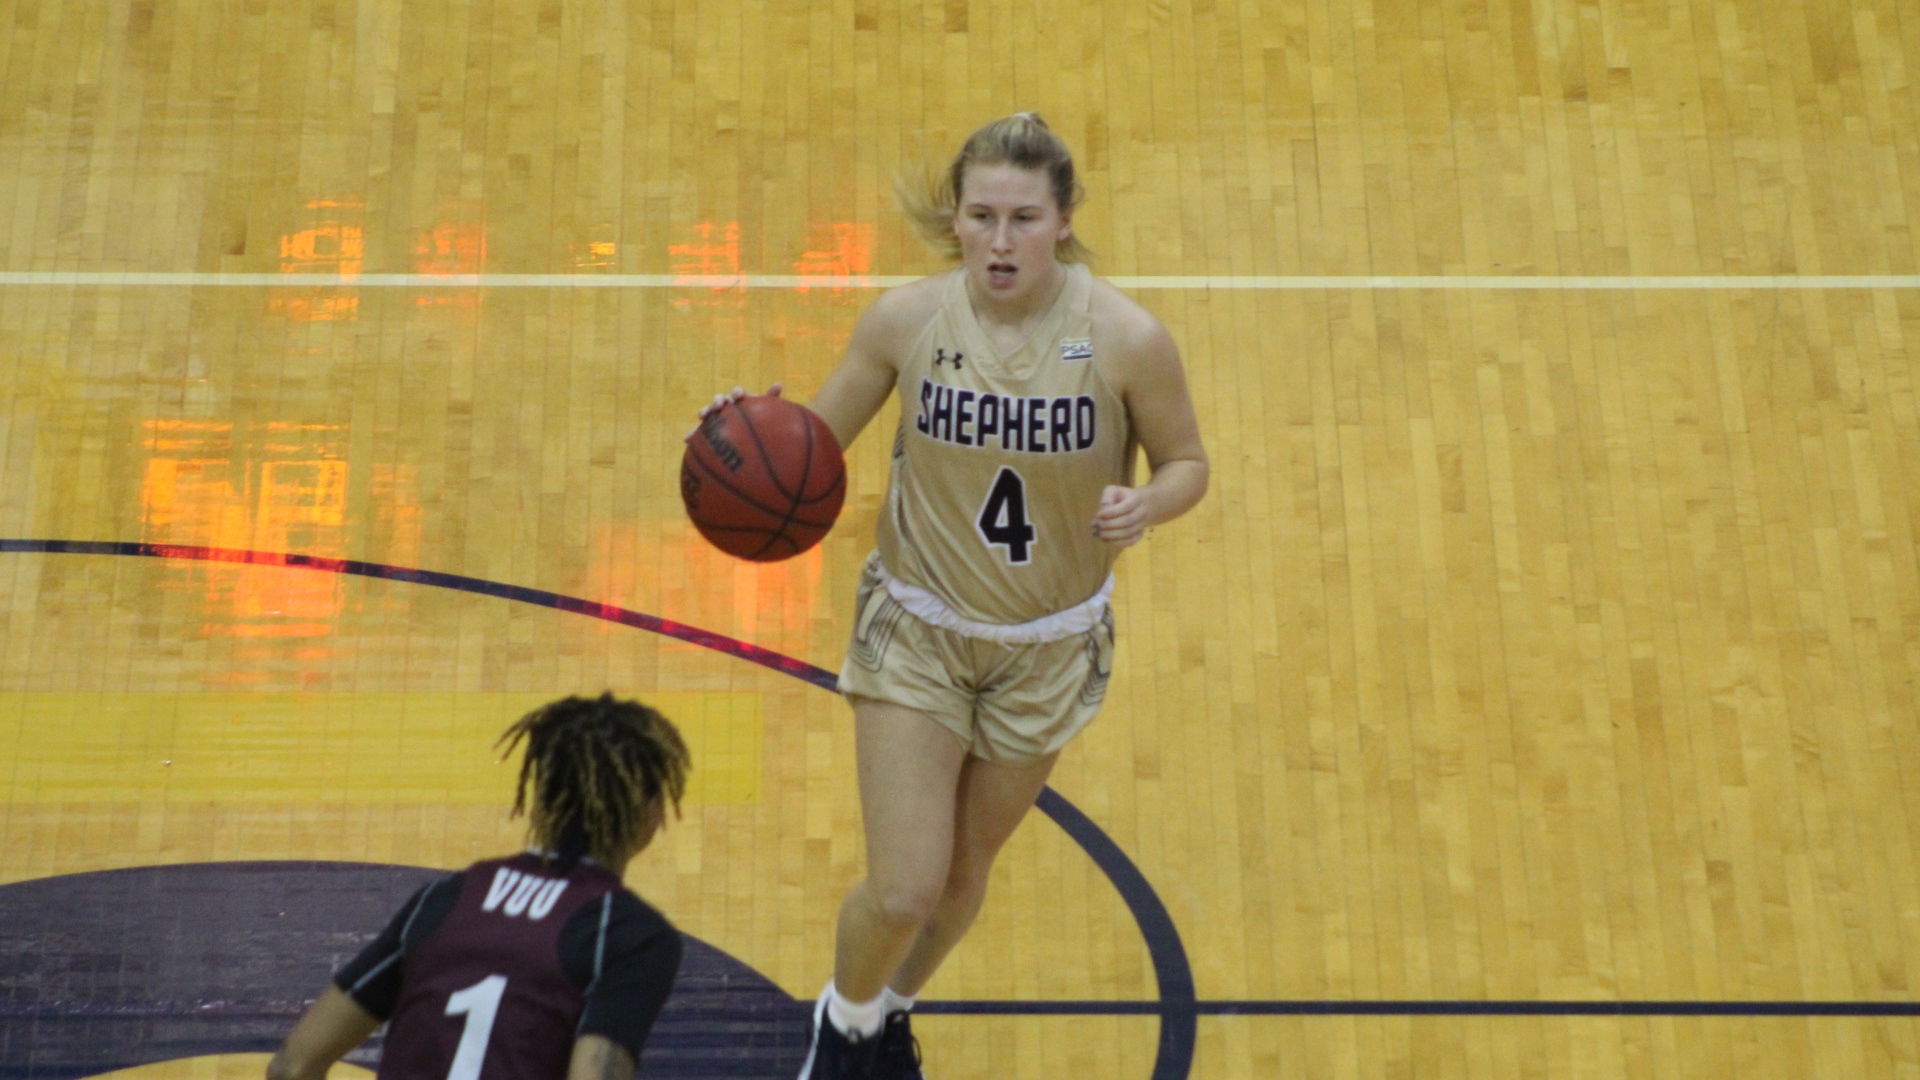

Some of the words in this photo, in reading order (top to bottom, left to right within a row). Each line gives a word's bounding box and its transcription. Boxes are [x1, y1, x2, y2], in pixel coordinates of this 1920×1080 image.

[917, 376, 1097, 454] SHEPHERD
[975, 465, 1037, 566] 4
[482, 866, 570, 921] VUU
[444, 973, 508, 1080] 1
